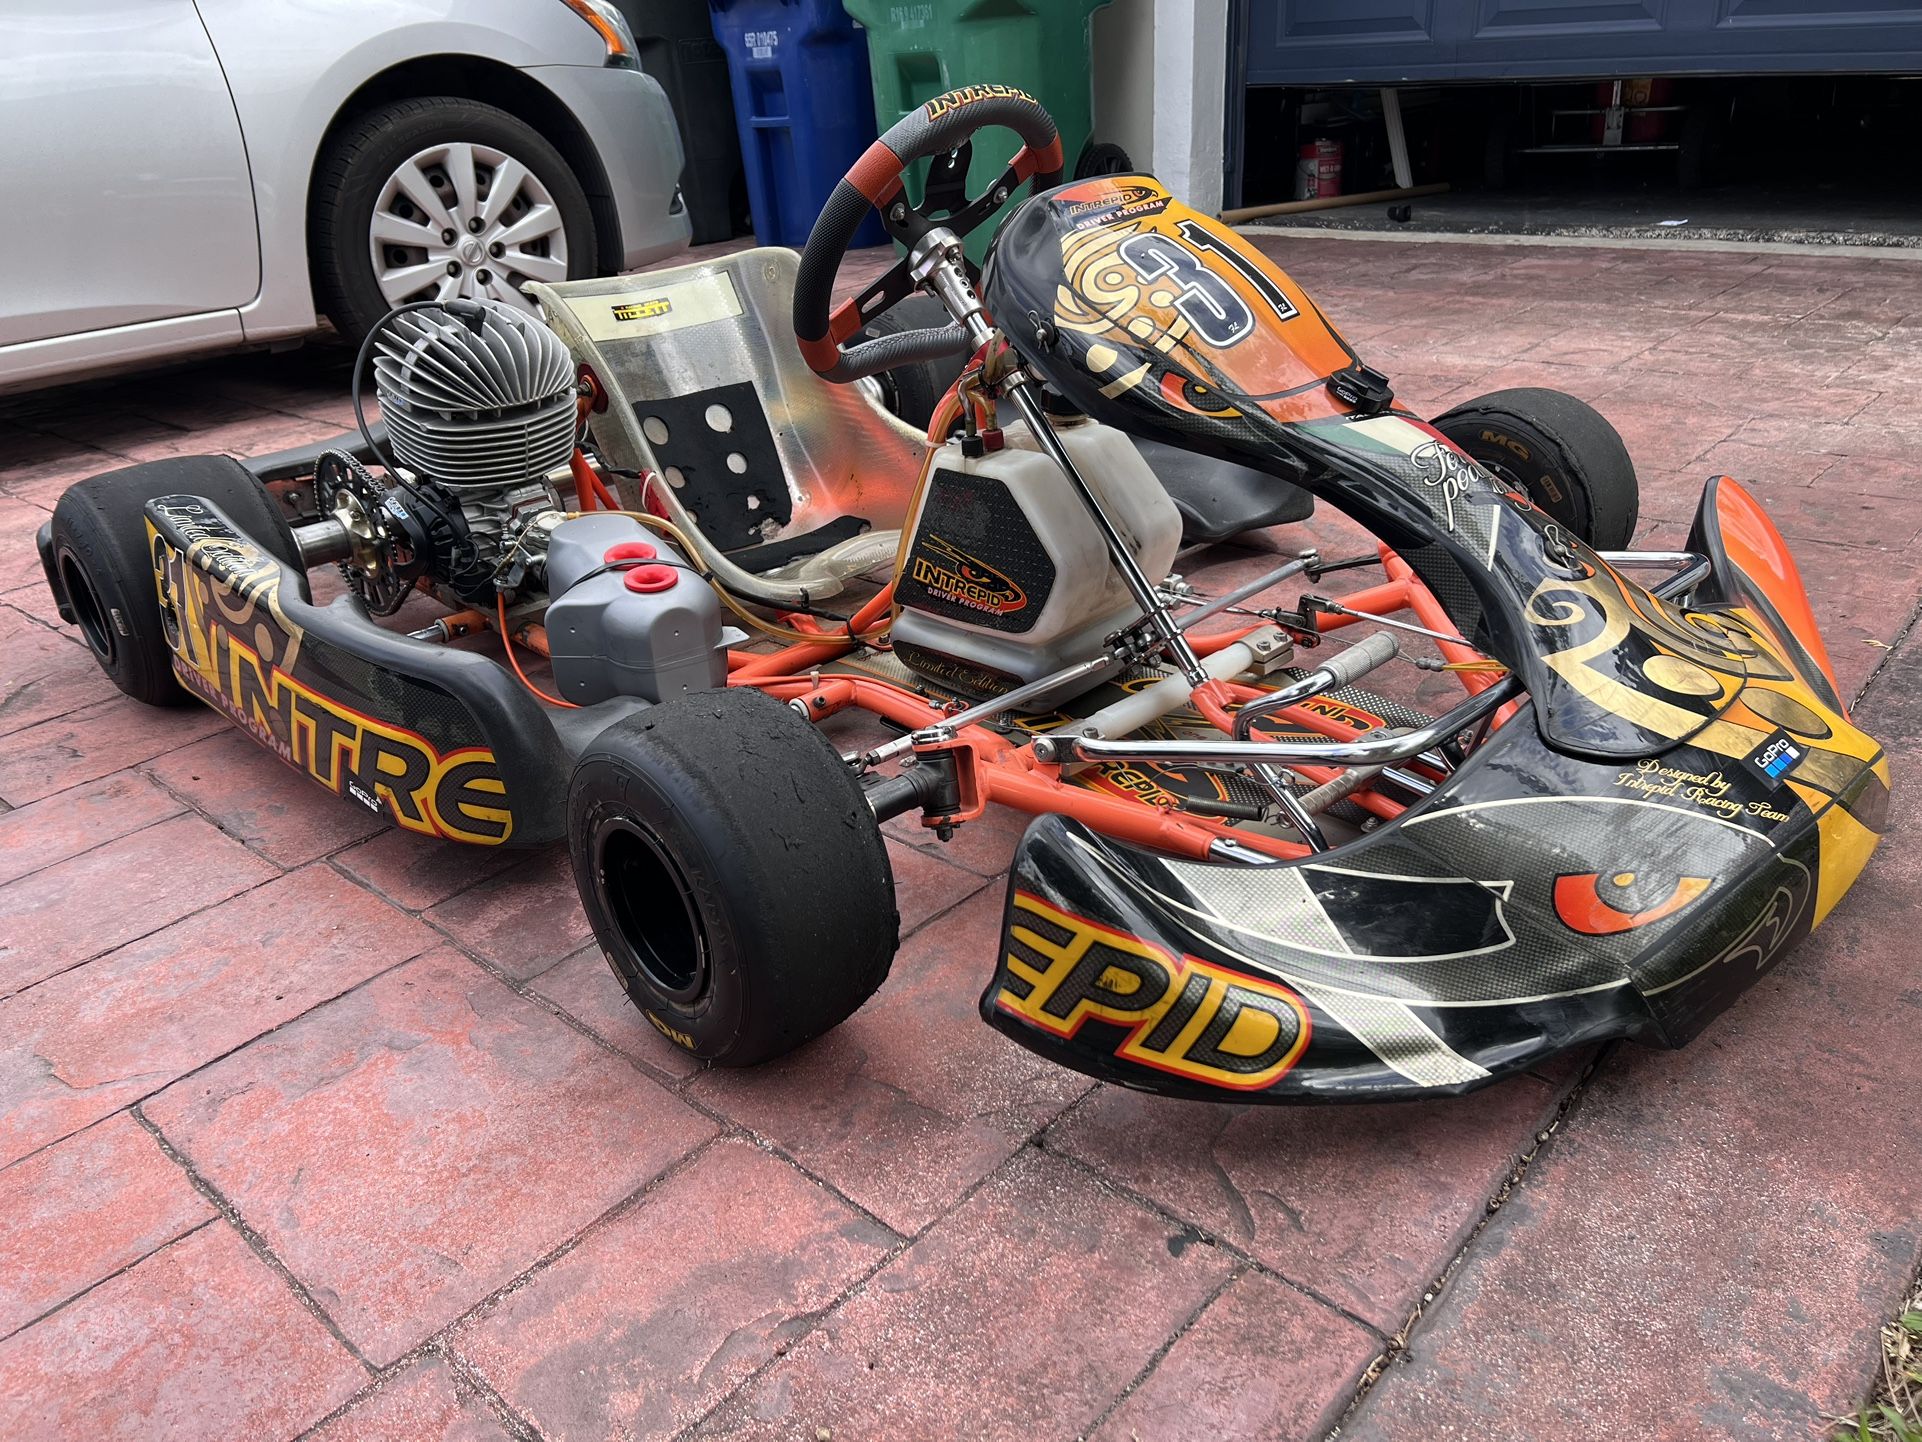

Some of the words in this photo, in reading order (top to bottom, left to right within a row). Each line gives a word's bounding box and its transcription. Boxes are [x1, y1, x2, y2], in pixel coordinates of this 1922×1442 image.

[924, 84, 1037, 122] INTREP
[1070, 194, 1132, 215] INTREPID
[1076, 213, 1114, 230] DRIVER
[1115, 200, 1164, 218] PROGRAM
[913, 557, 1004, 608] INTREPID
[927, 586, 957, 602] DRIVER
[959, 597, 1004, 616] PROGRAM
[173, 655, 218, 701] DRIVER
[220, 692, 292, 762] PROGRAM
[1755, 738, 1790, 769] GoPro
[1636, 758, 1710, 786] Designed
[1705, 771, 1733, 798] by
[1613, 772, 1685, 799] Intrepid
[1681, 786, 1744, 819] Racing
[1745, 801, 1791, 823] Team
